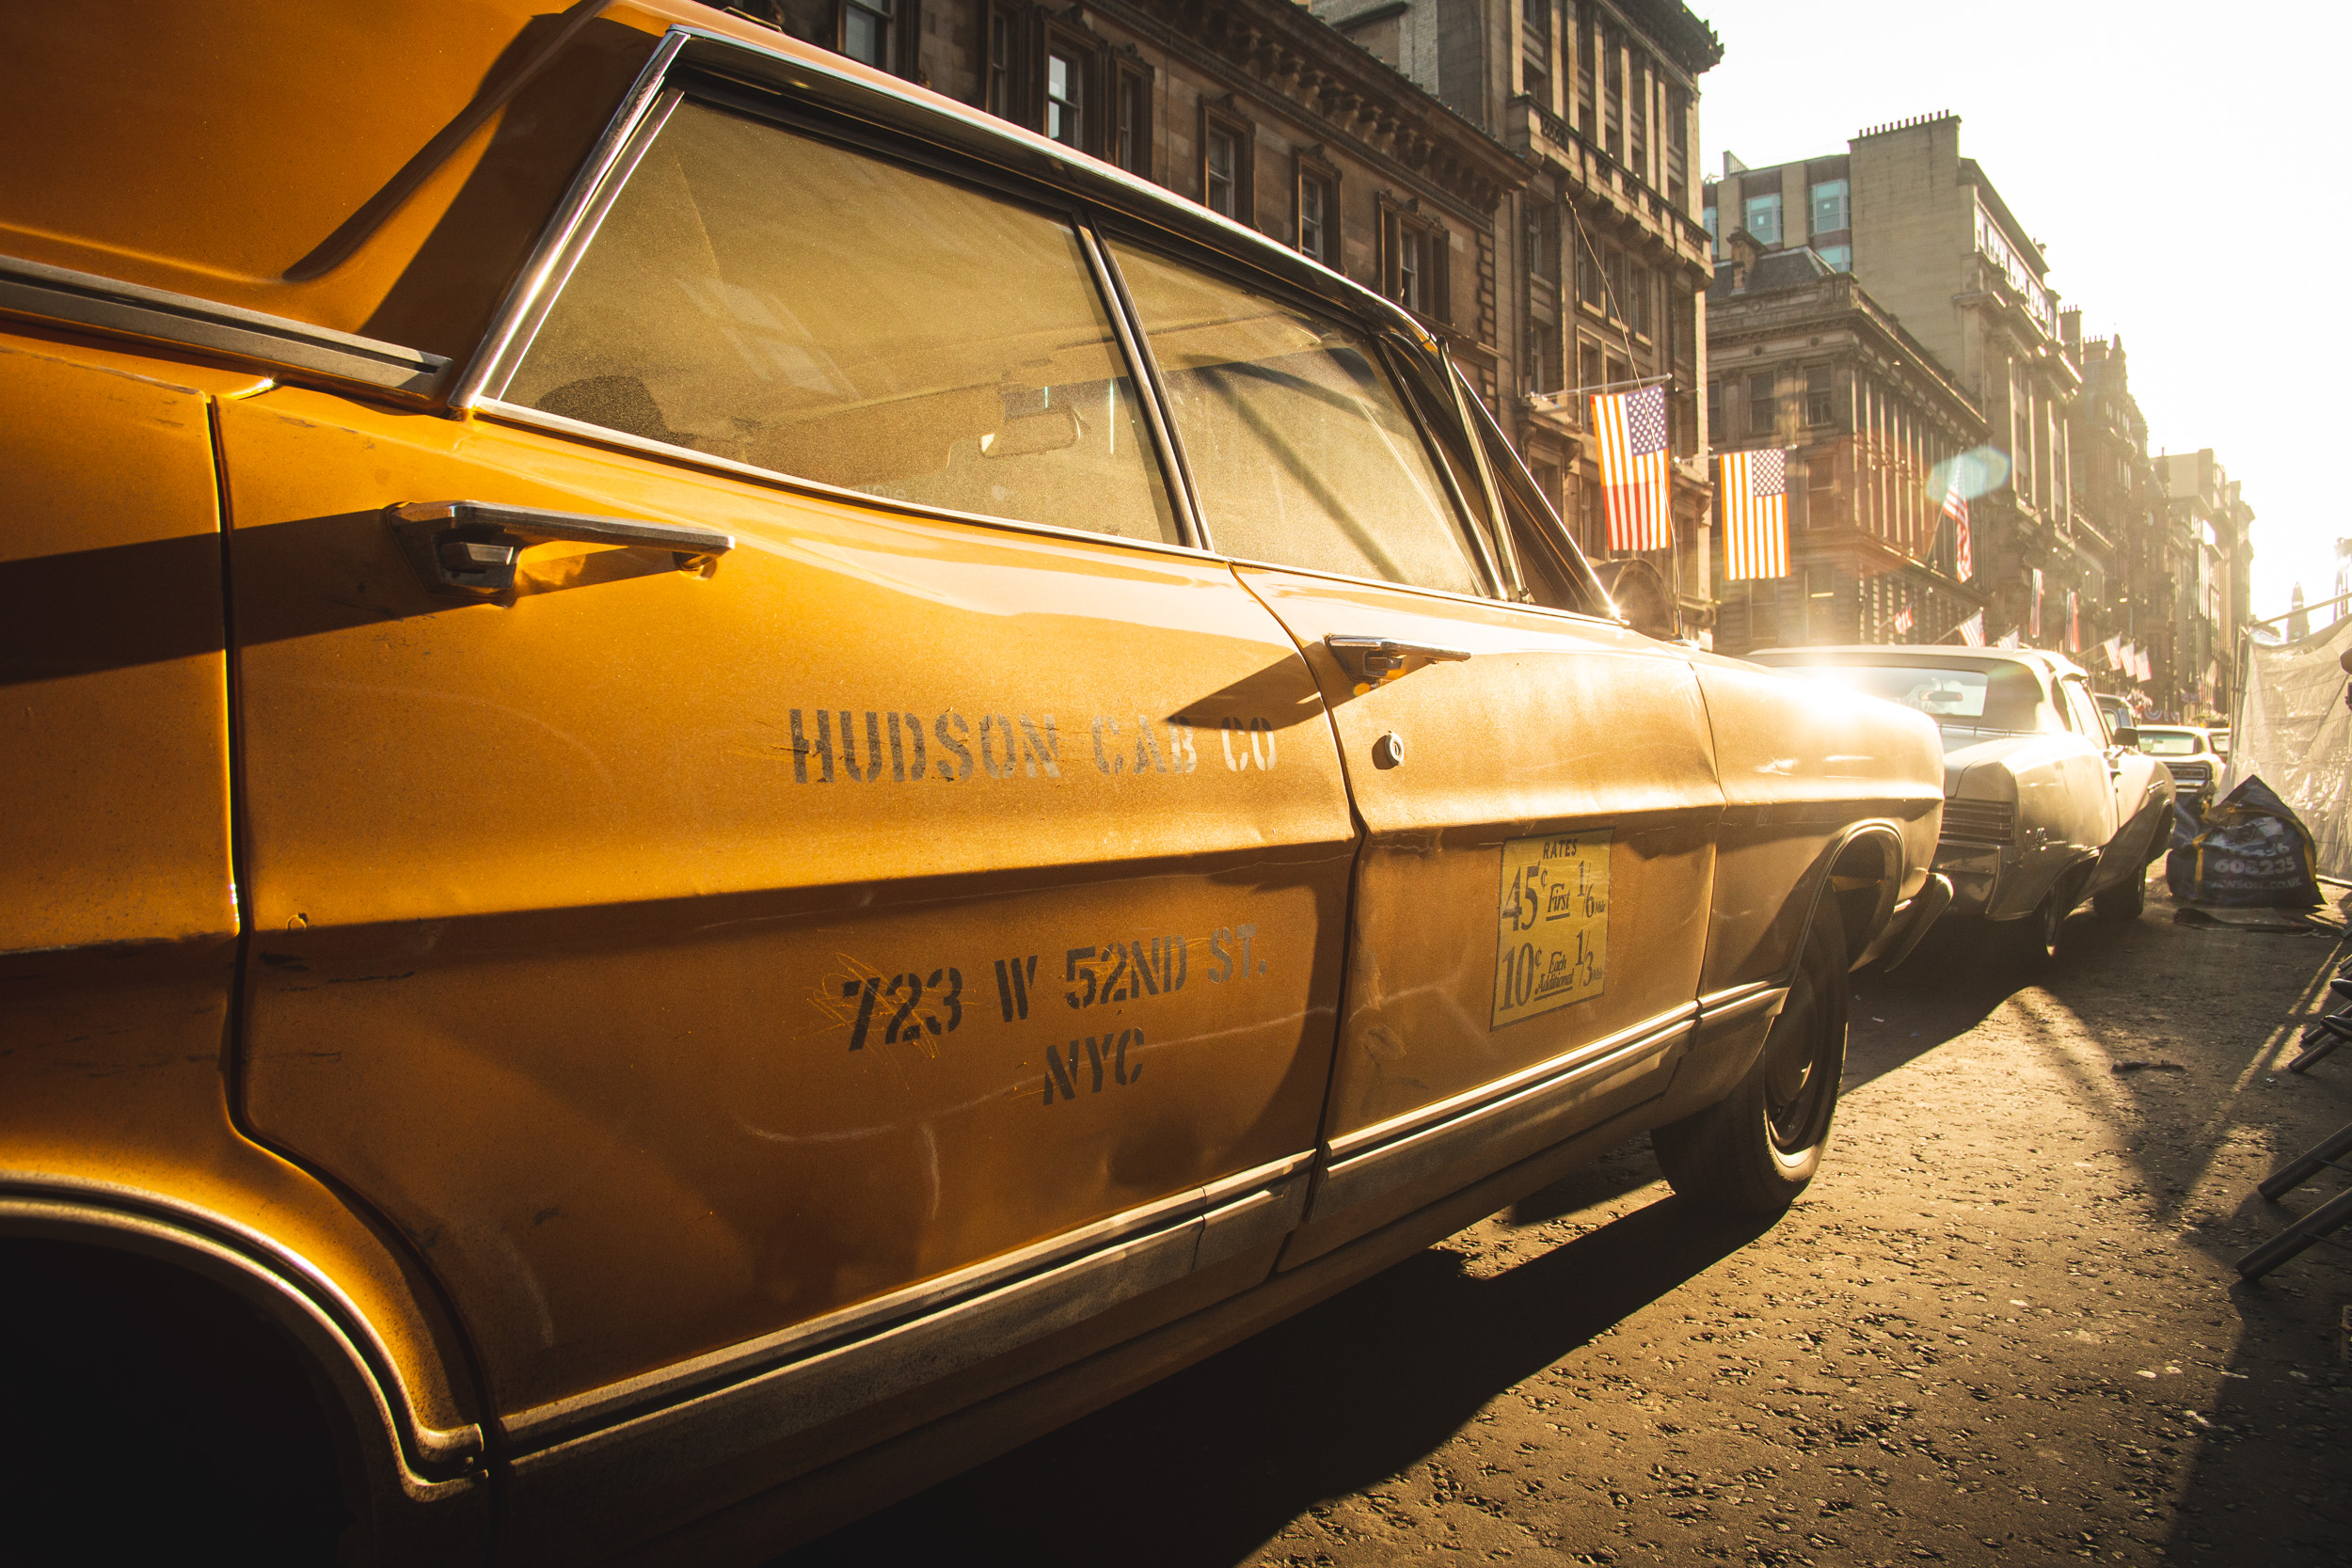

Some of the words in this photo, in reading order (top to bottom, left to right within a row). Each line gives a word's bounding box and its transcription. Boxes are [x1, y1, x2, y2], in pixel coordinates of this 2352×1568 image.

[788, 709, 1060, 784] HUDSON
[1091, 715, 1198, 774] CAB
[1220, 717, 1278, 771] CO
[1543, 838, 1578, 860] RATES
[1548, 883, 1570, 912] First
[1549, 951, 1566, 974] Each
[842, 967, 962, 1052] 723
[994, 955, 1038, 1022] W
[1066, 934, 1188, 1009] 52ND
[1208, 923, 1267, 985] ST.
[1534, 968, 1575, 994] Additional
[1042, 1028, 1144, 1106] NYC
